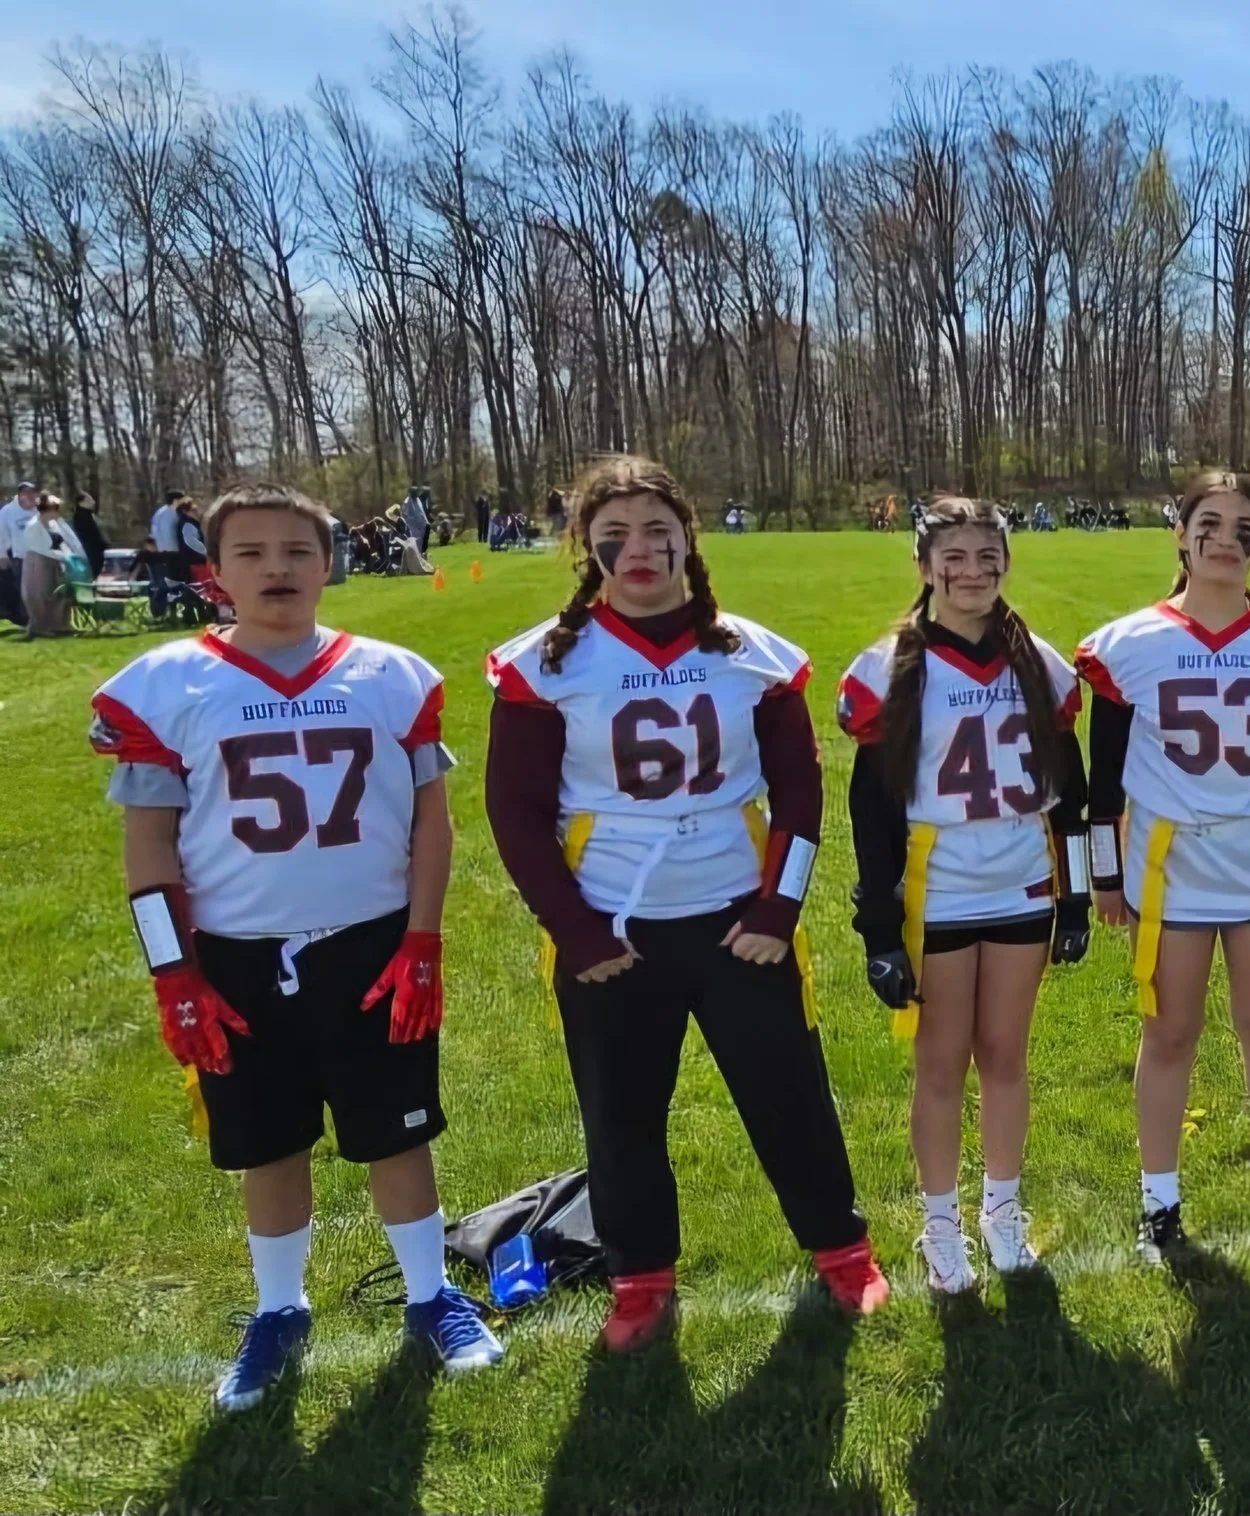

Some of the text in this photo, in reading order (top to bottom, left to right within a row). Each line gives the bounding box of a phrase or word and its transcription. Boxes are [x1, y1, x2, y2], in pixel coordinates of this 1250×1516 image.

[218, 727, 374, 854] 57
[611, 693, 726, 801] 61
[937, 713, 1044, 820] 43
